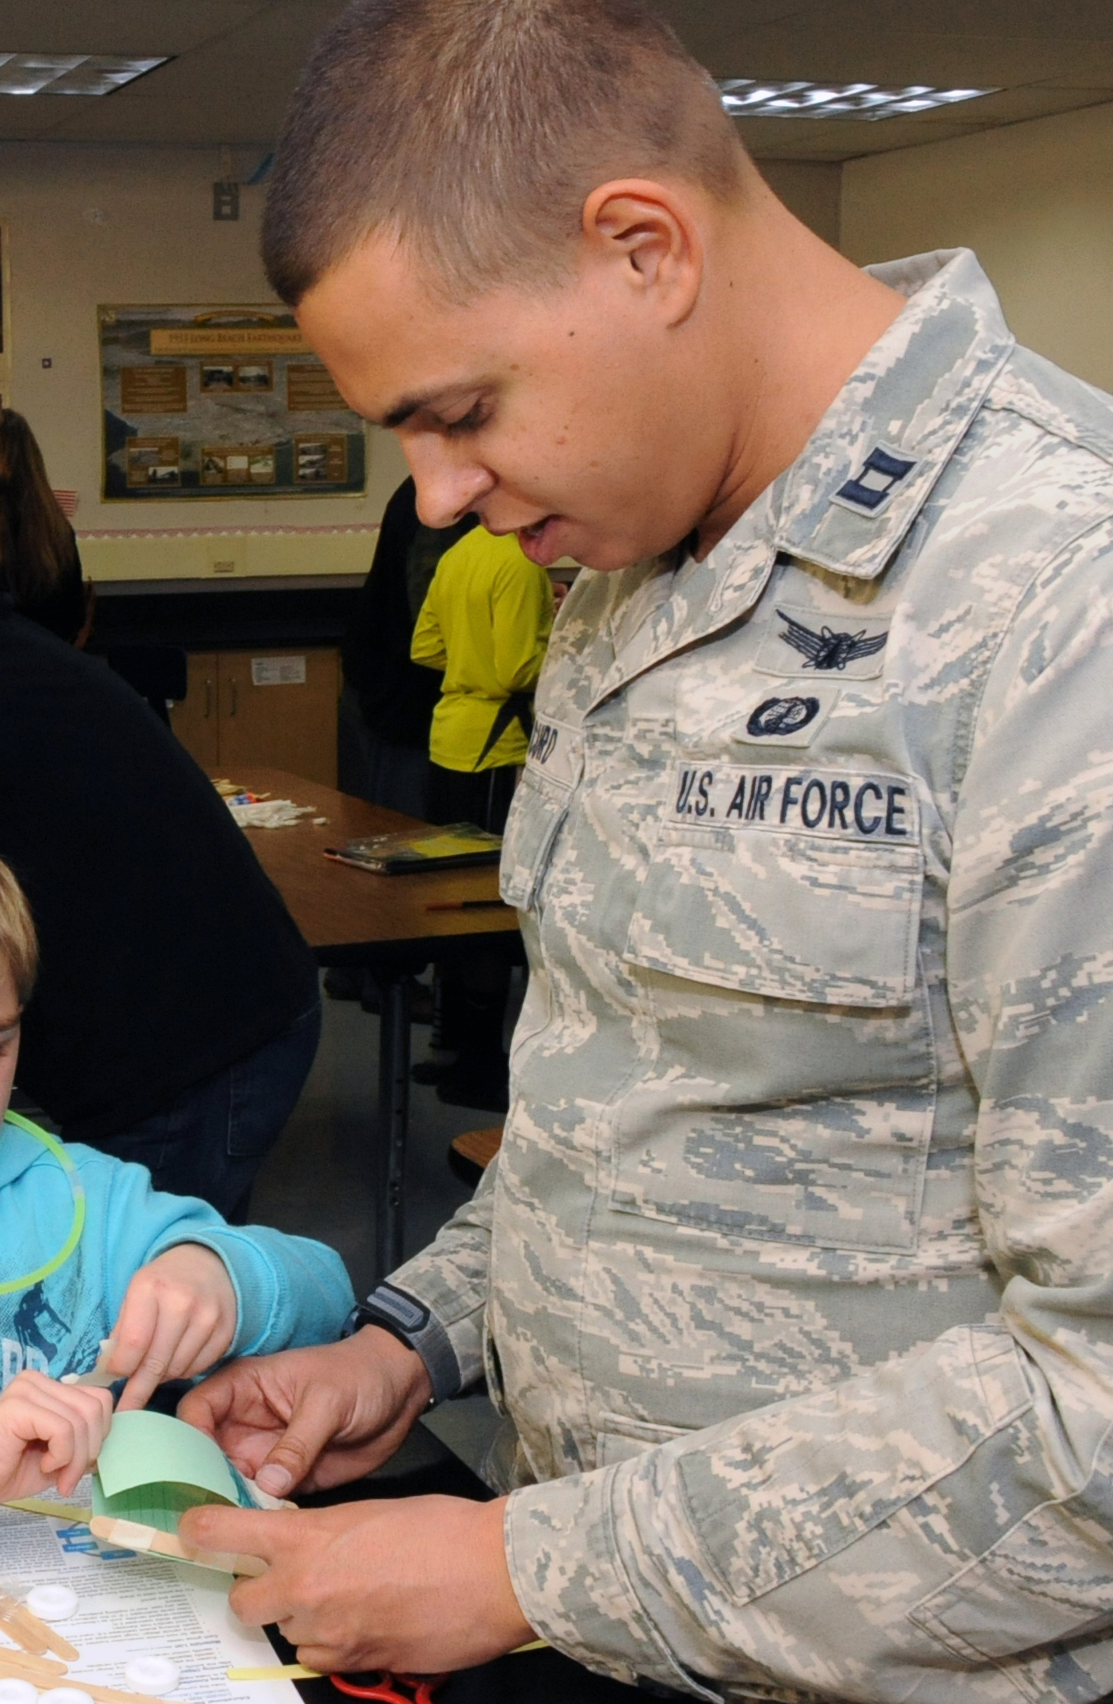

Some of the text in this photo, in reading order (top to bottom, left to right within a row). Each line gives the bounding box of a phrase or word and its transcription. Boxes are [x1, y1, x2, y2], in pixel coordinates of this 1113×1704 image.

[676, 770, 908, 836] U.S. AIR FORCE
